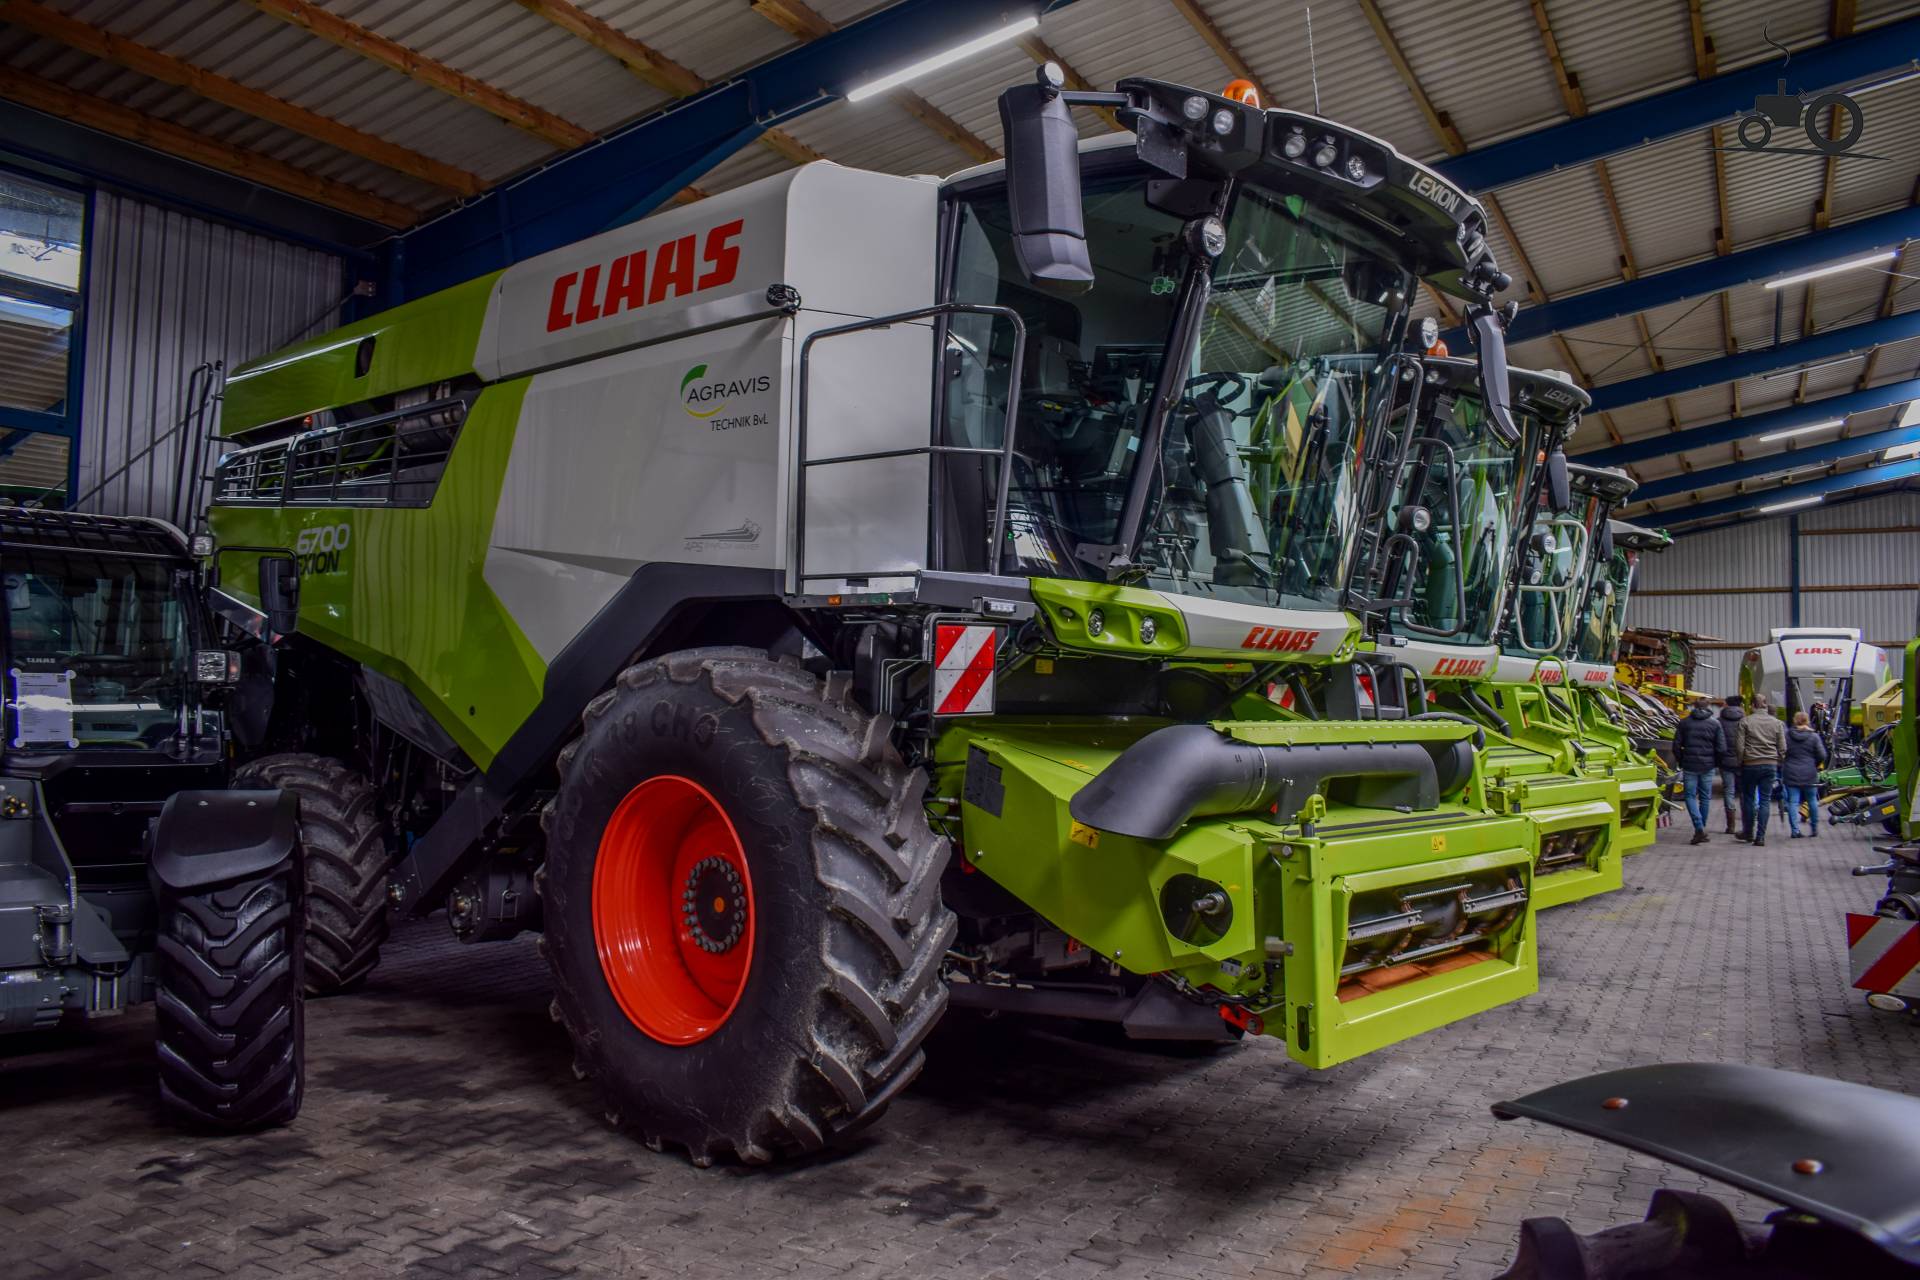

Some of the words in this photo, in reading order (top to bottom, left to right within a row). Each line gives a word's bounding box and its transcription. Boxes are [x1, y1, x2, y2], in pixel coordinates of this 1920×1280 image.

[1409, 171, 1459, 213] LEXION
[546, 218, 744, 333] CLAAS
[687, 376, 770, 404] AGRAVIS
[710, 416, 751, 431] TECHNIK
[753, 413, 769, 426] BvL
[297, 523, 350, 555] 6700
[1241, 625, 1320, 652] CLAAS
[1794, 647, 1843, 655] CLAAS
[1432, 658, 1486, 676] CLAAS
